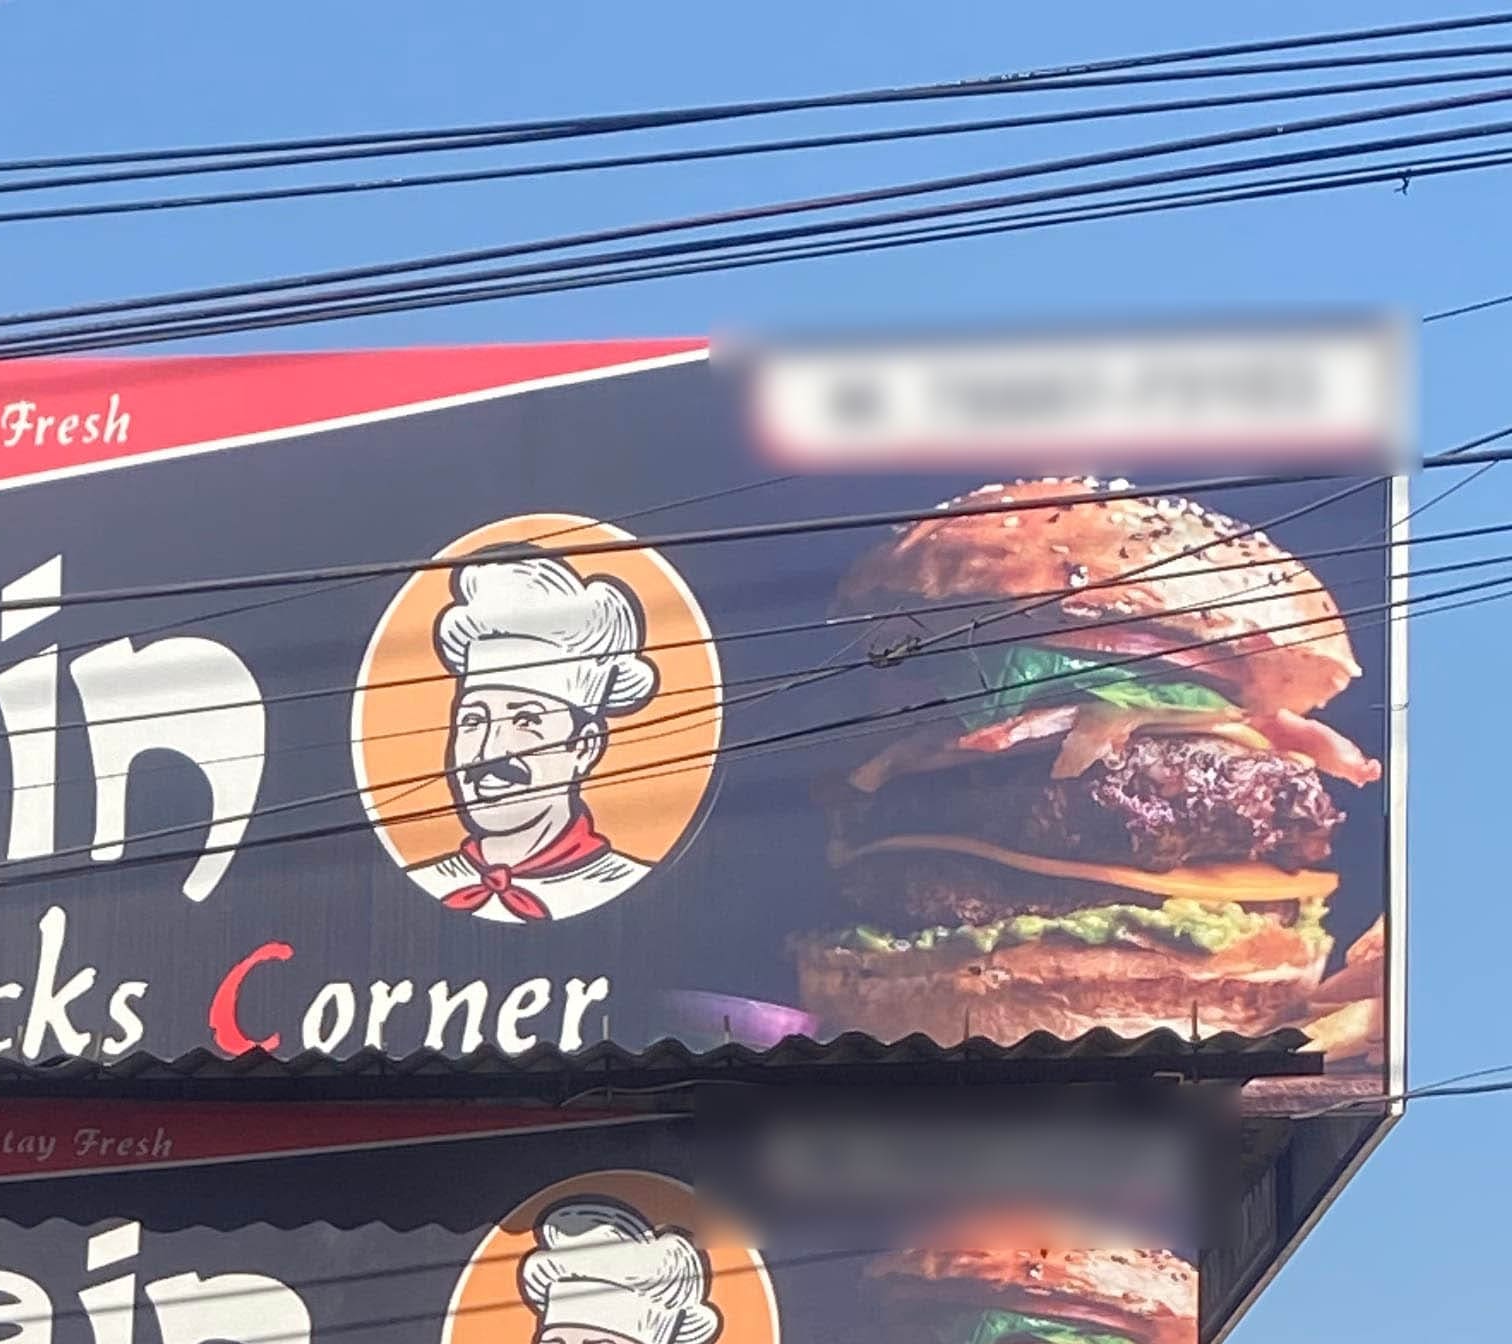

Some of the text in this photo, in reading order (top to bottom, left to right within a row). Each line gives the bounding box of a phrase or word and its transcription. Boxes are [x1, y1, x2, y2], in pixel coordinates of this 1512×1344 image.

[0, 395, 131, 448] Fresh
[209, 940, 610, 1056] Corner
[73, 1128, 173, 1158] Fresh
